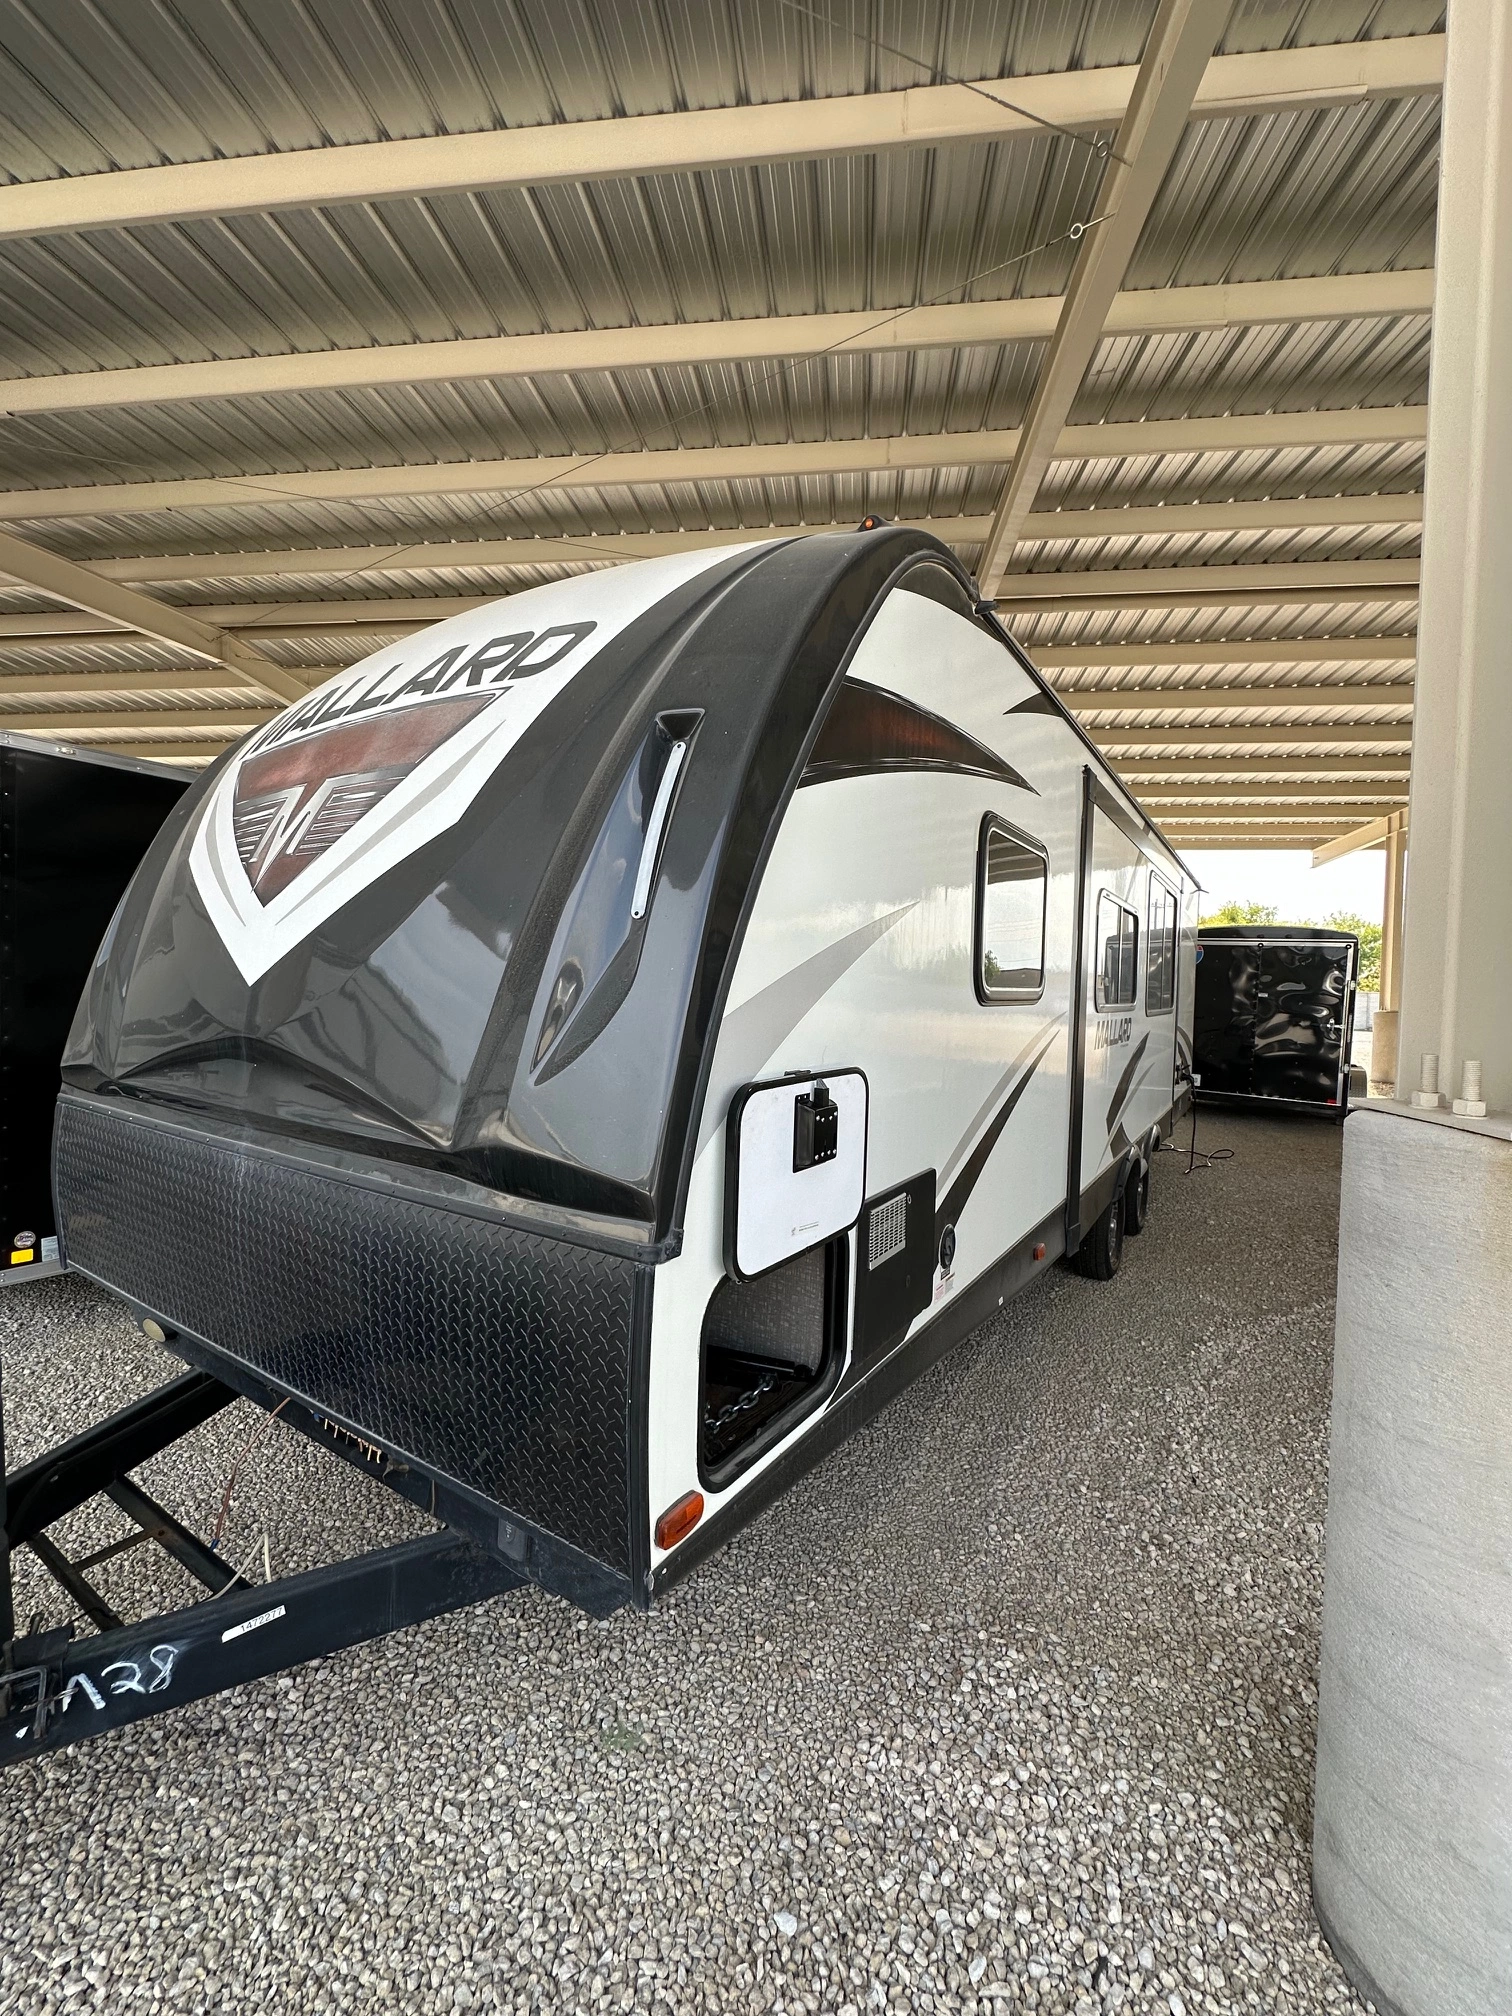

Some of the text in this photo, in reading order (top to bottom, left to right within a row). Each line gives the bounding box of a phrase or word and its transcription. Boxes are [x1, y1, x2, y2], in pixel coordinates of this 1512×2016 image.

[238, 620, 598, 762] MALLARD
[1094, 1017, 1132, 1050] MALLARD
[241, 1607, 283, 1632] 1472277
